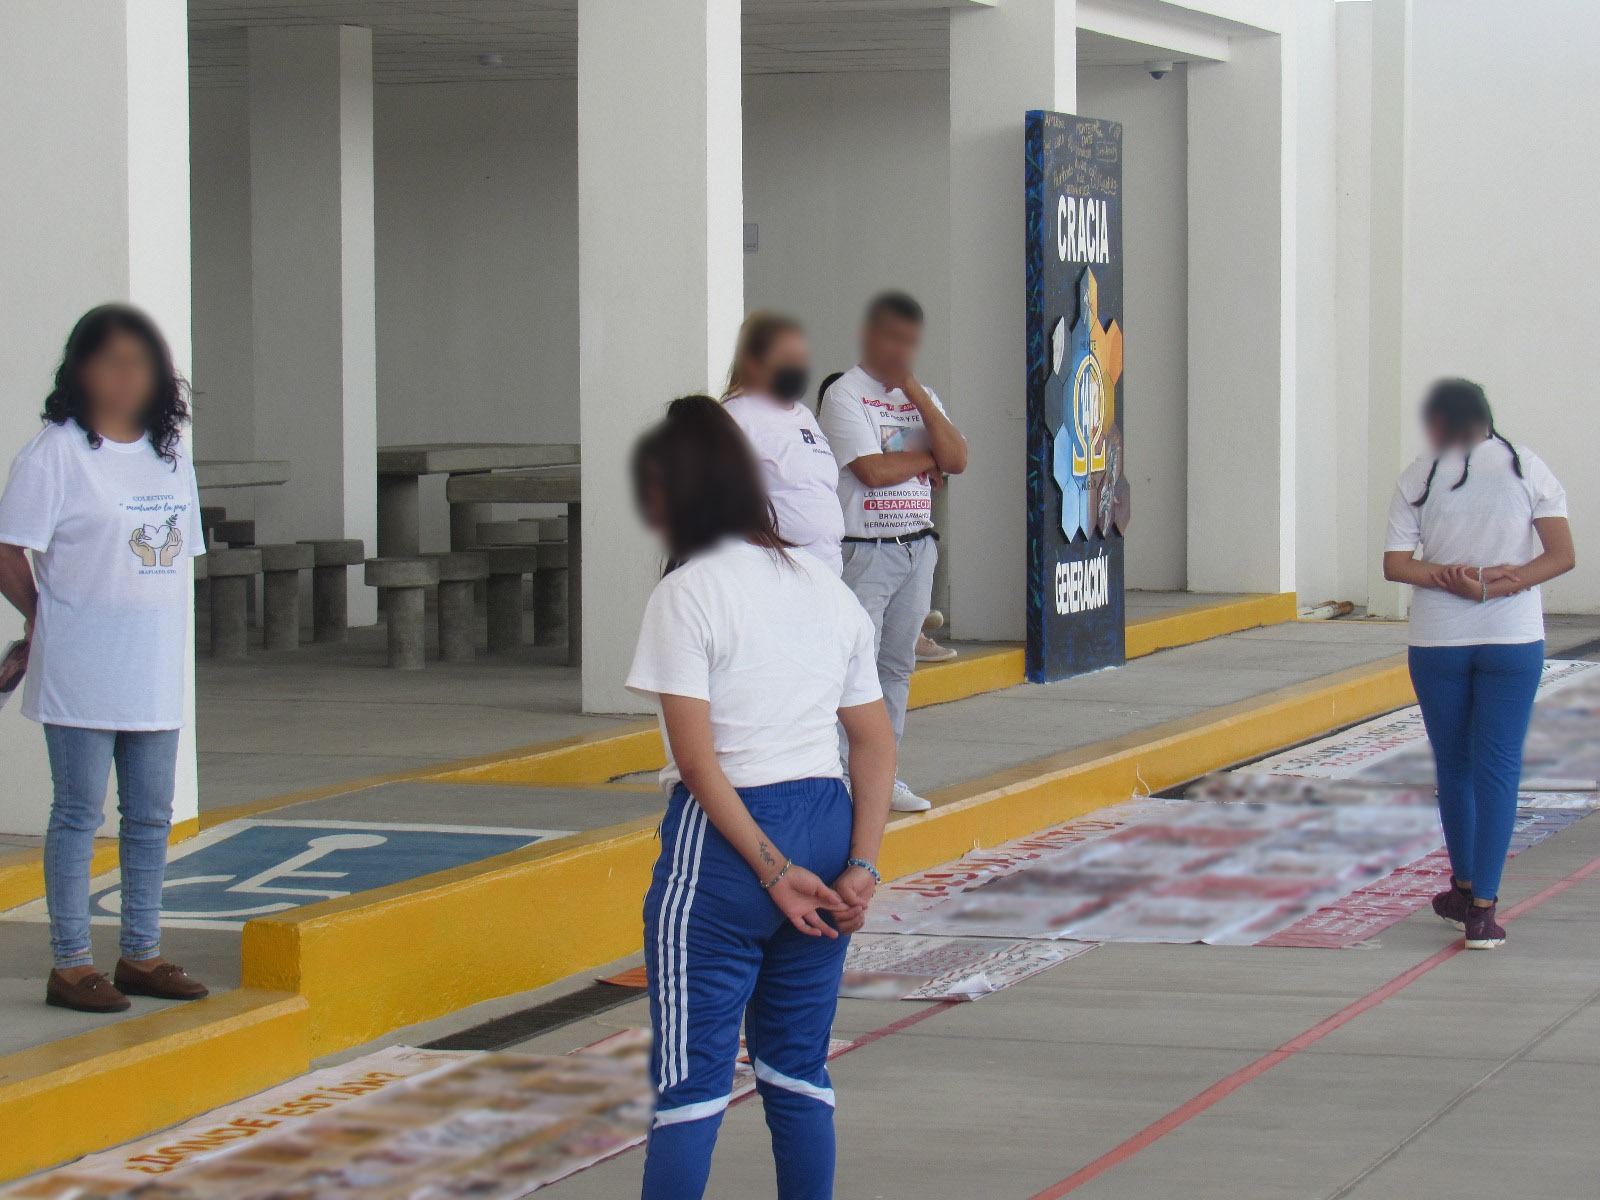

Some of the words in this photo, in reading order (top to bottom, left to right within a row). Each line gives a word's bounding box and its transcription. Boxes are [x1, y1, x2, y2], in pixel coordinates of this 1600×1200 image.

[1058, 195, 1109, 263] CRACIA
[878, 512, 904, 520] BRYAN
[1055, 547, 1108, 616] GENERACIÓN
